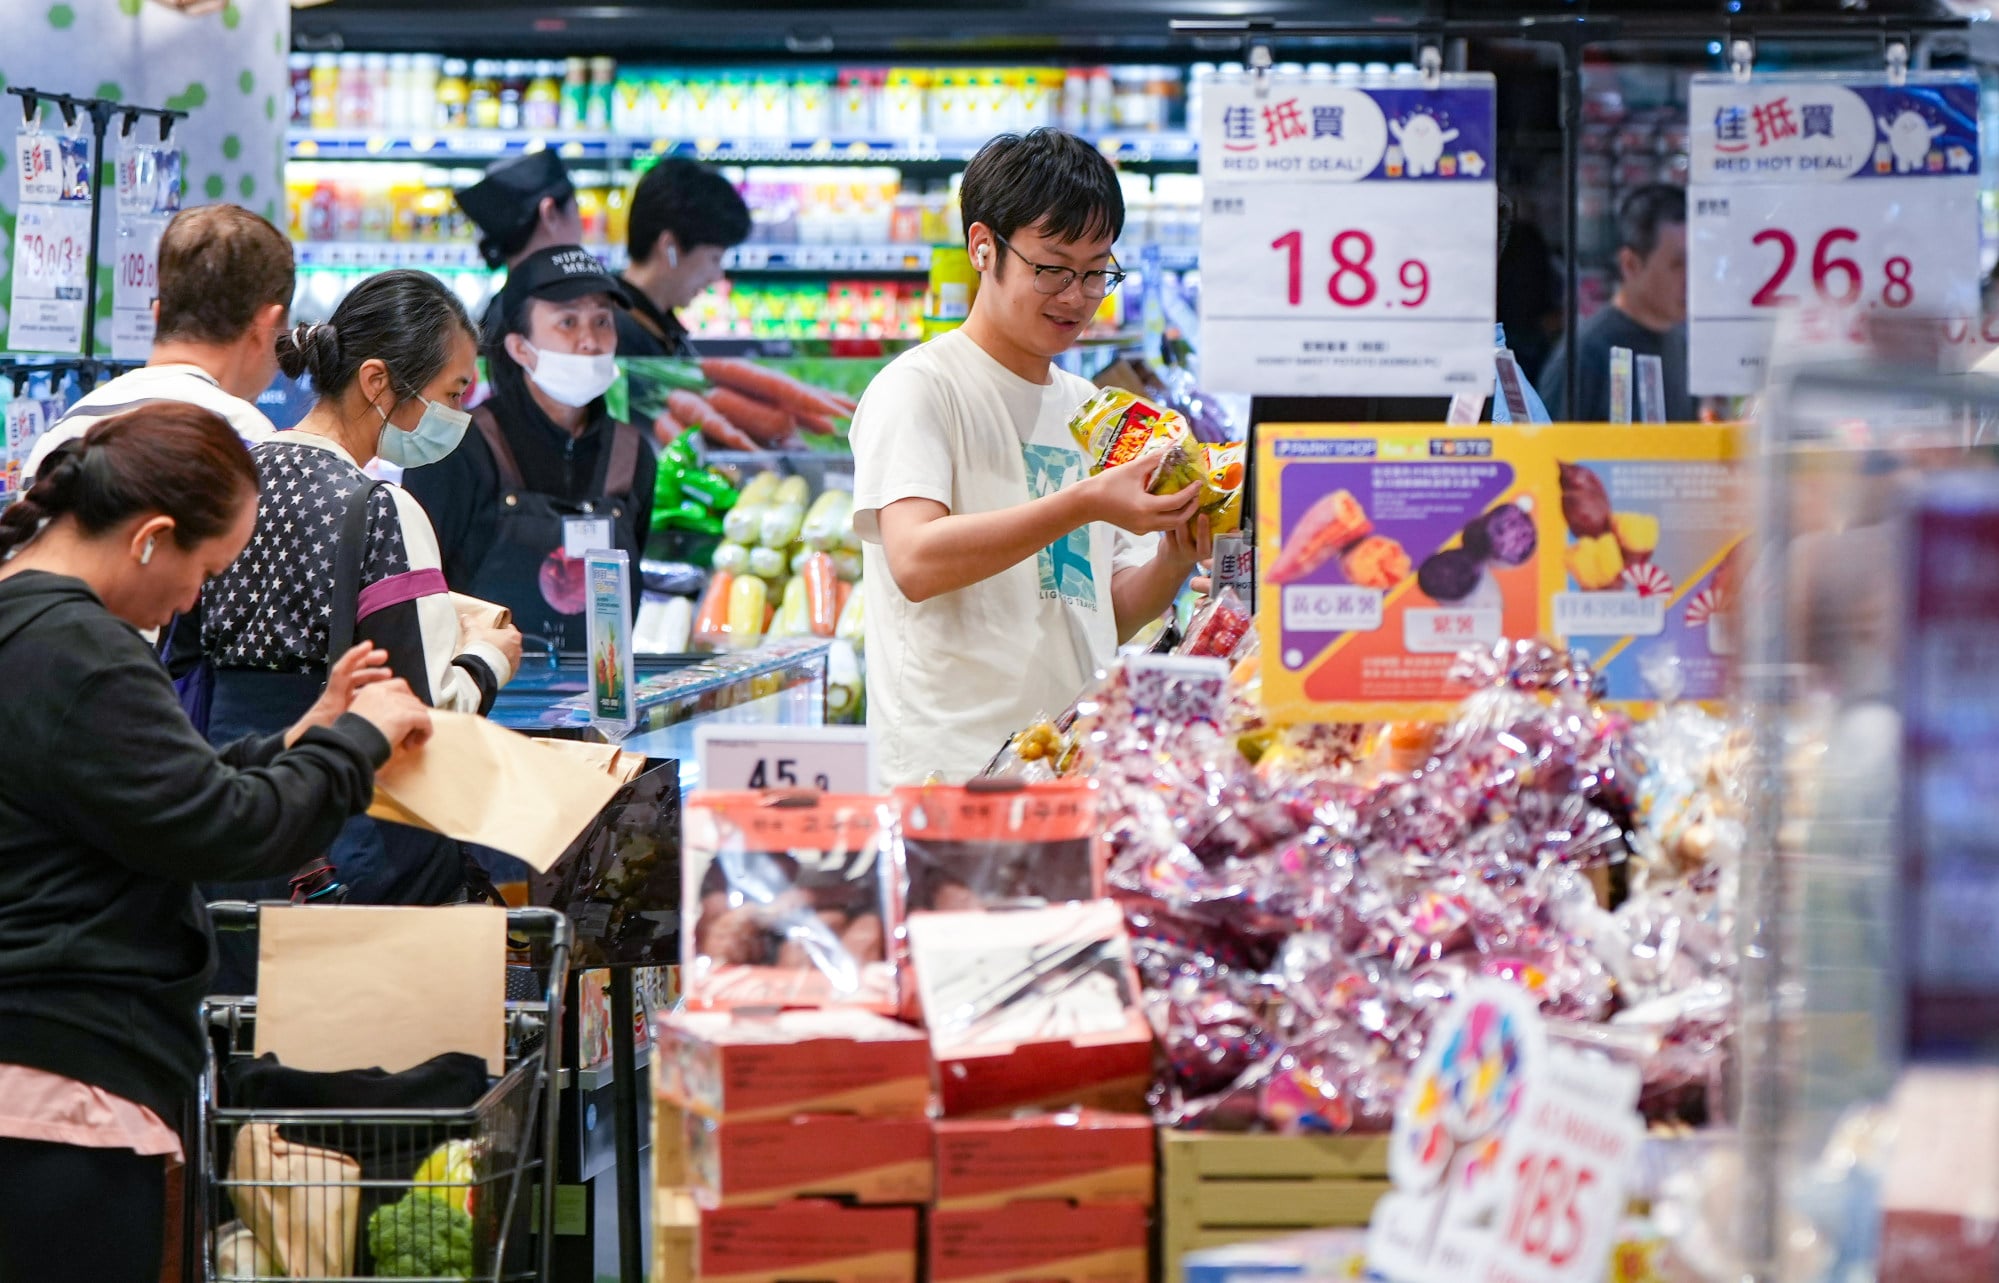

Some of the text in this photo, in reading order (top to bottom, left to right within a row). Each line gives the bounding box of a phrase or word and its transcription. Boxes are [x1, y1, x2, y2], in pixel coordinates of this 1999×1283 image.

[1223, 98, 1344, 146] 佳抵買
[1714, 98, 1835, 147] 佳抵買
[1223, 155, 1363, 172] RED HOT DEAL!
[1714, 157, 1751, 171] RED
[1757, 156, 1792, 171] HOT
[1271, 229, 1431, 309] 18.9
[1751, 227, 1914, 308] 26.8
